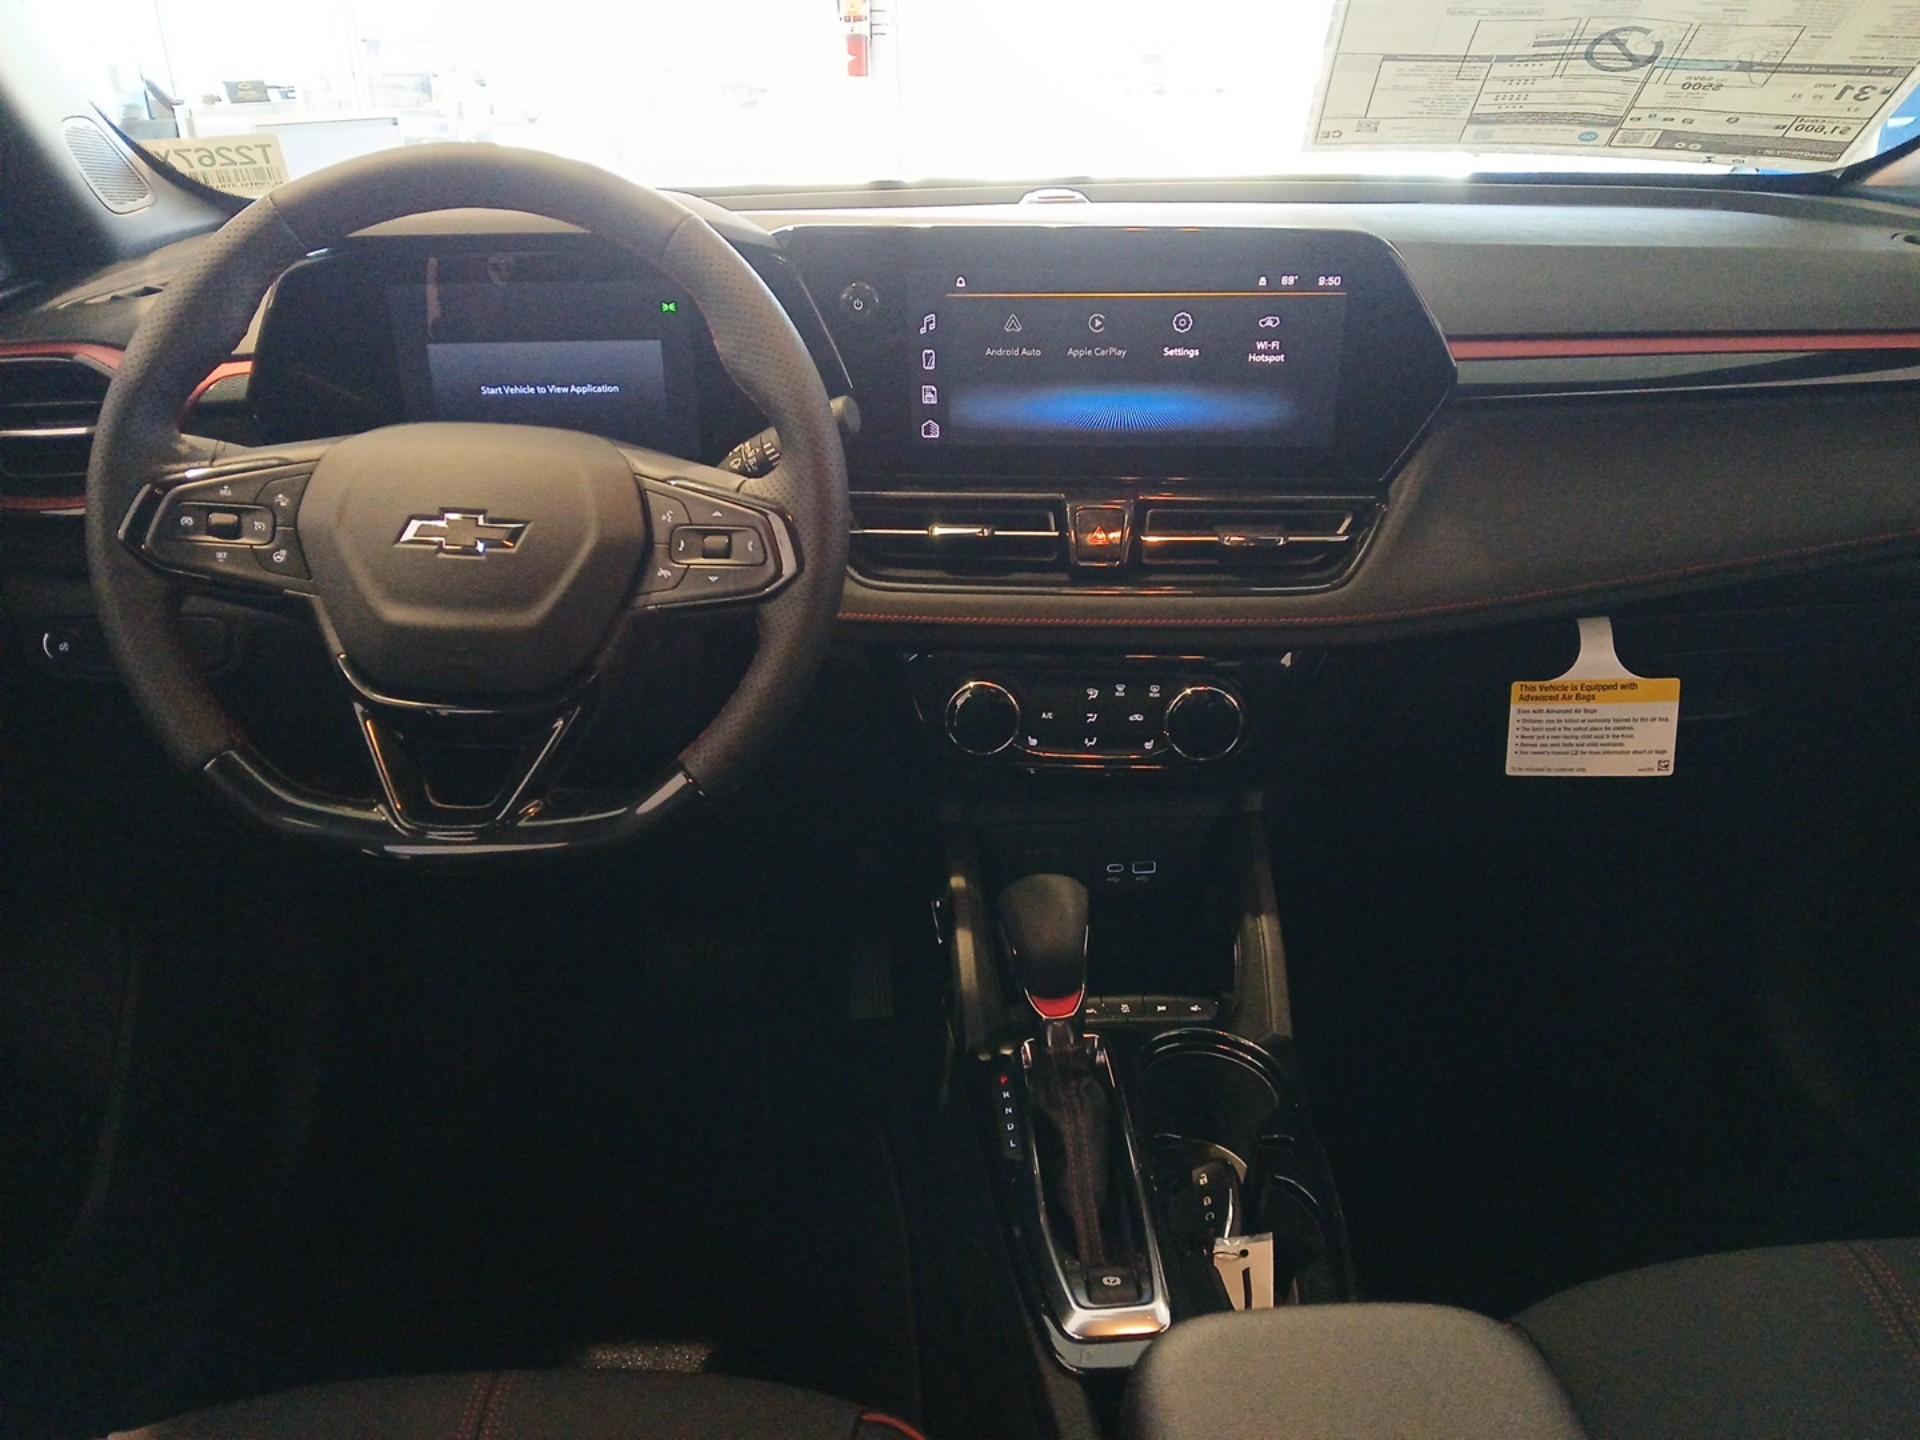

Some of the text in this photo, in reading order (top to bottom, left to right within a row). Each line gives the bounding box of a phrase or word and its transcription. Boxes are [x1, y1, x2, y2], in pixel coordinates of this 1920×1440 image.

[1256, 340, 1280, 350] Wi-Fi
[985, 347, 1042, 356] Android Auto
[1067, 347, 1128, 358] Apple CarPlay
[1163, 347, 1200, 358] Settings
[1248, 353, 1285, 363] Hotspot
[480, 383, 620, 395] Start Vehicle to View Application
[1519, 682, 1638, 692] This Vehicle is Equipped with
[1518, 693, 1596, 702] Advanced Air Bags
[1007, 1123, 1014, 1131] D
